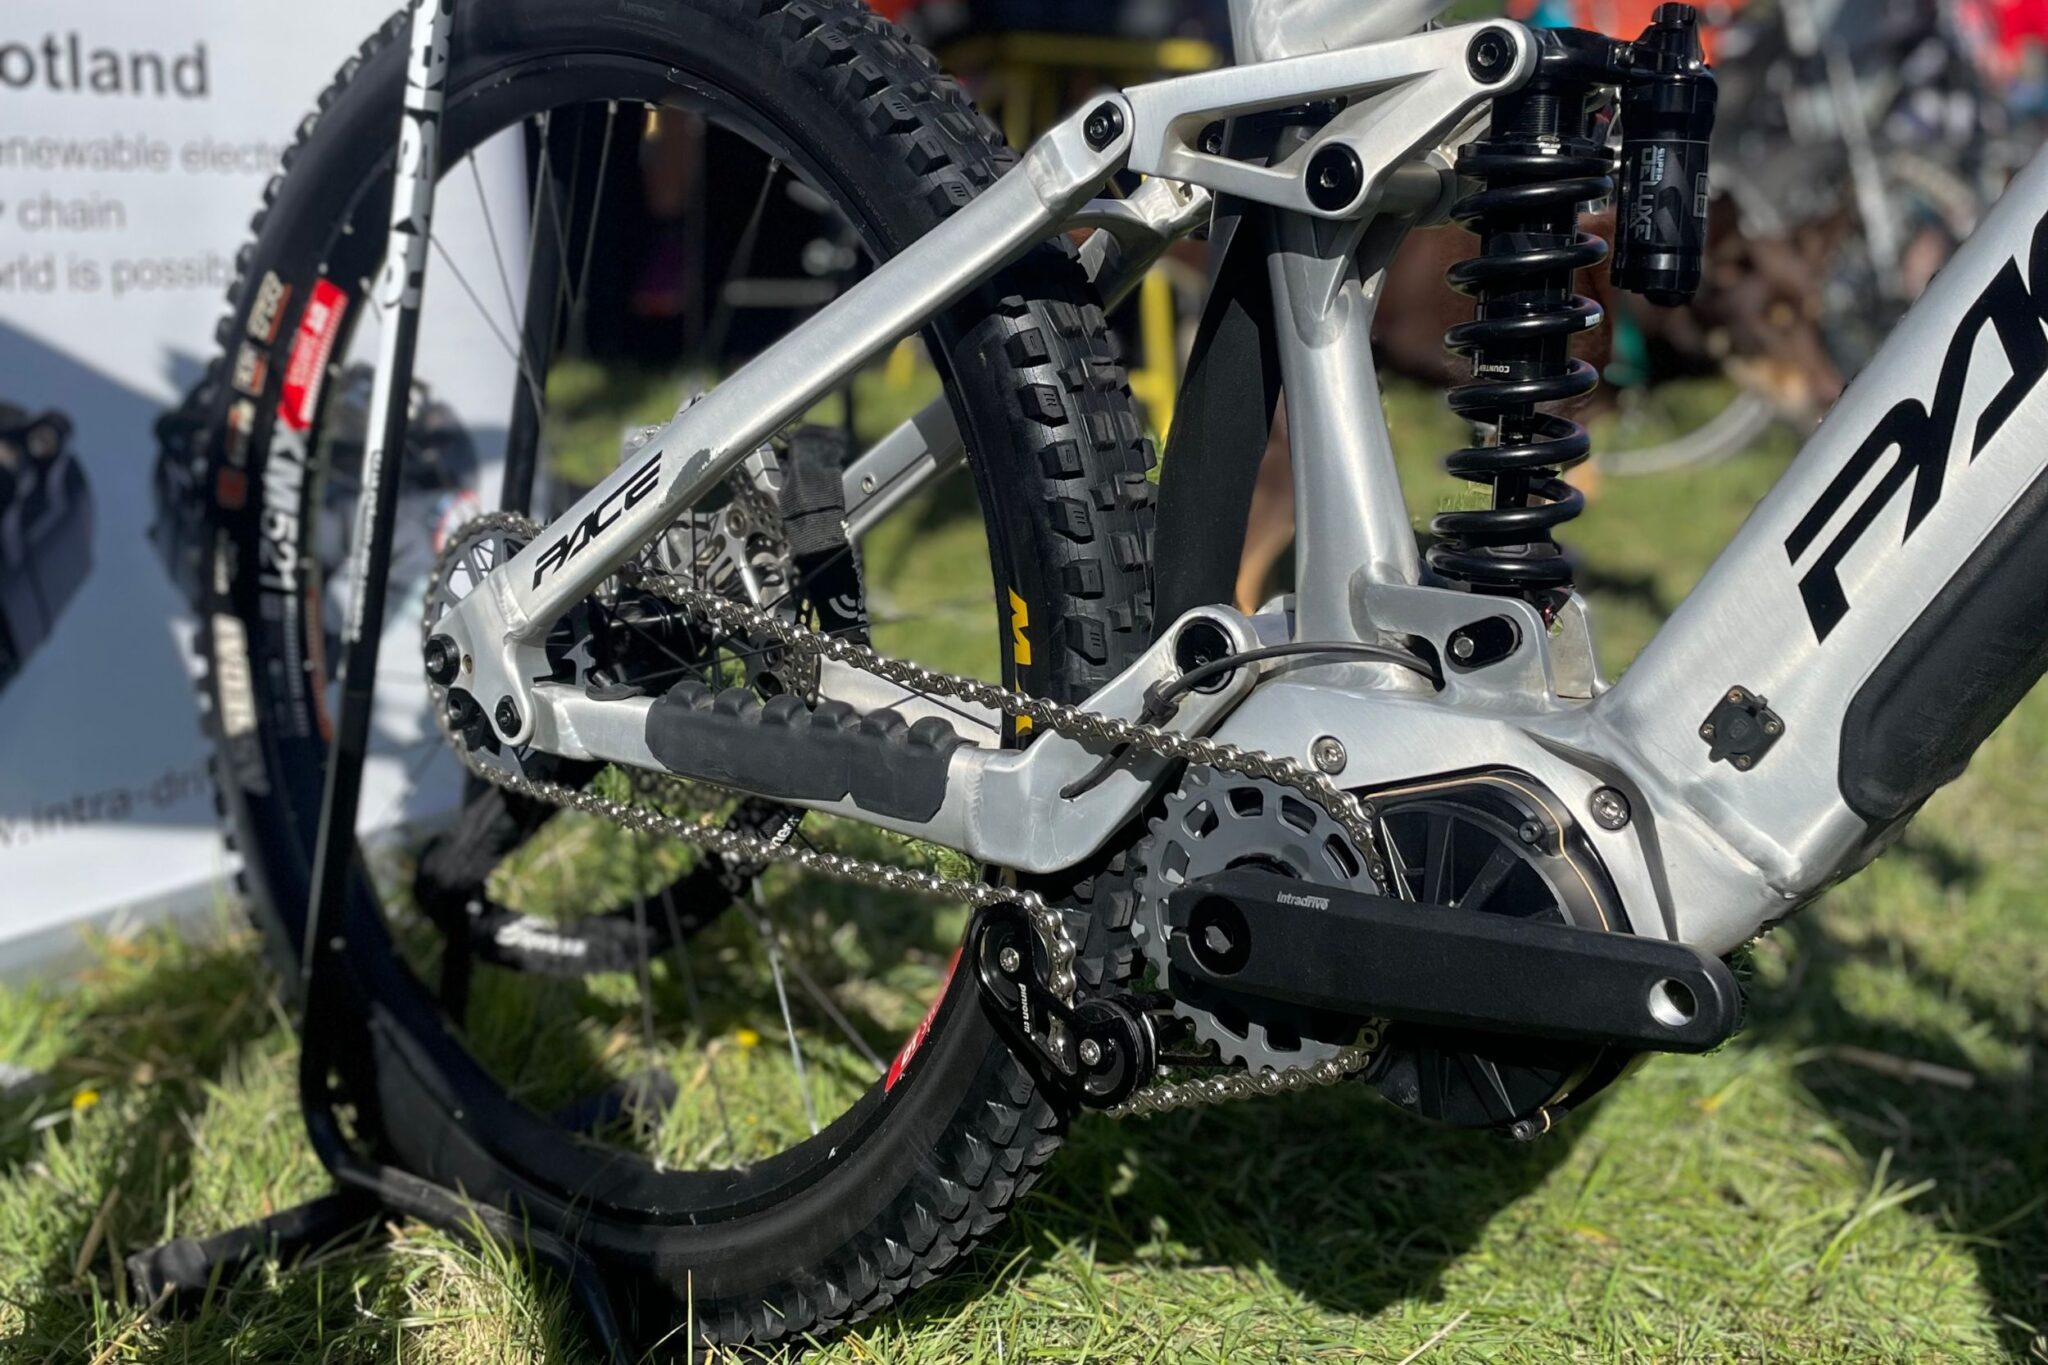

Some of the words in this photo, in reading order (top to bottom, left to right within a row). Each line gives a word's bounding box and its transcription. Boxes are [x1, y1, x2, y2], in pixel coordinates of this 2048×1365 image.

[0, 134, 171, 172] newable
[1655, 147, 1666, 181] SUPER
[17, 190, 128, 233] chain
[532, 449, 663, 592] PACE
[1276, 890, 1331, 911] intradrive
[1017, 982, 1029, 1021] pinion
